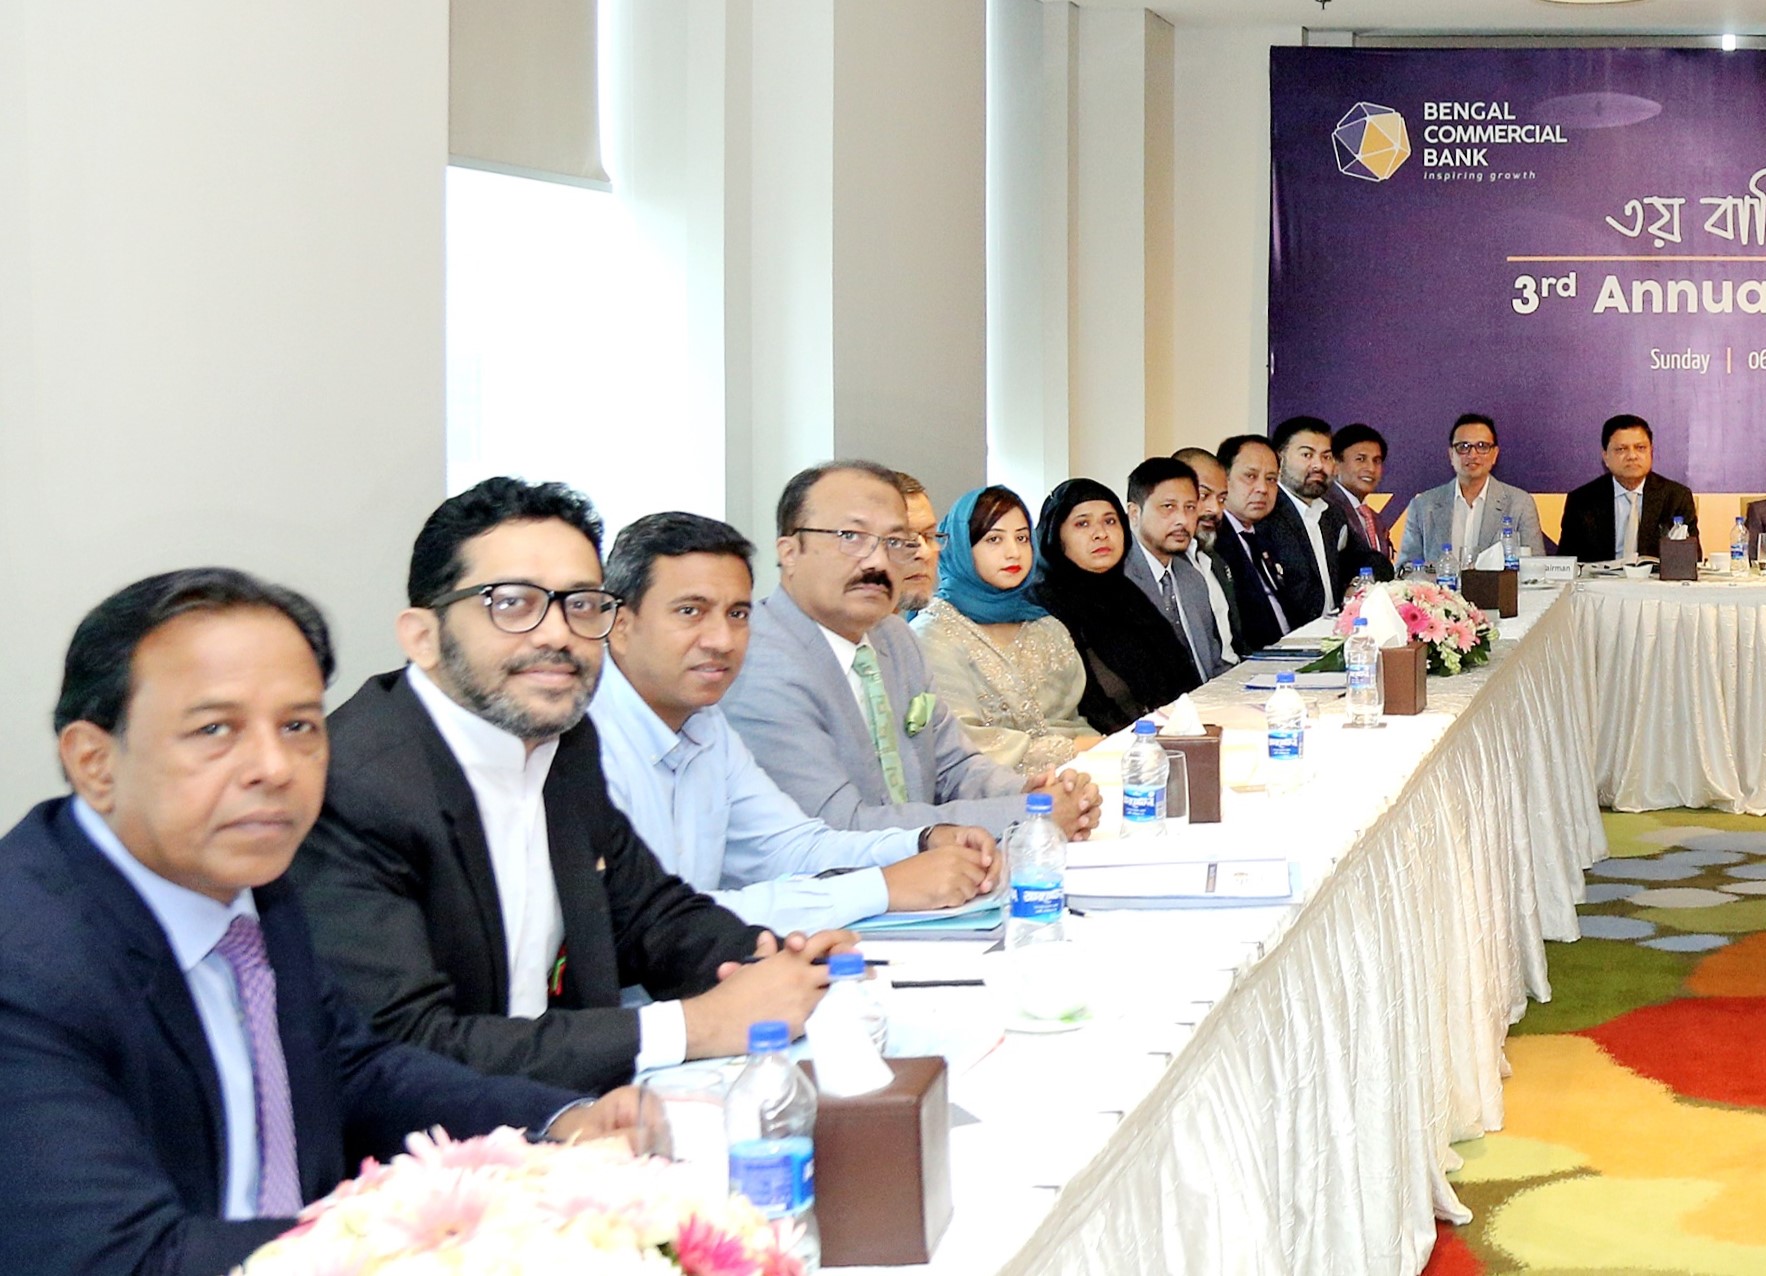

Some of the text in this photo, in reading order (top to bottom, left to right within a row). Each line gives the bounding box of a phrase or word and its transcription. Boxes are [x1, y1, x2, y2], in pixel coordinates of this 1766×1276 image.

[1424, 101, 1516, 120] BENGAL
[1424, 124, 1568, 144] COMMERCIAL
[1424, 148, 1489, 167] BANK
[1423, 170, 1537, 182] inspiring growth
[1605, 196, 1686, 248] ৩য়
[1512, 271, 1577, 314] 3rd
[1650, 347, 1711, 374] Sunday
